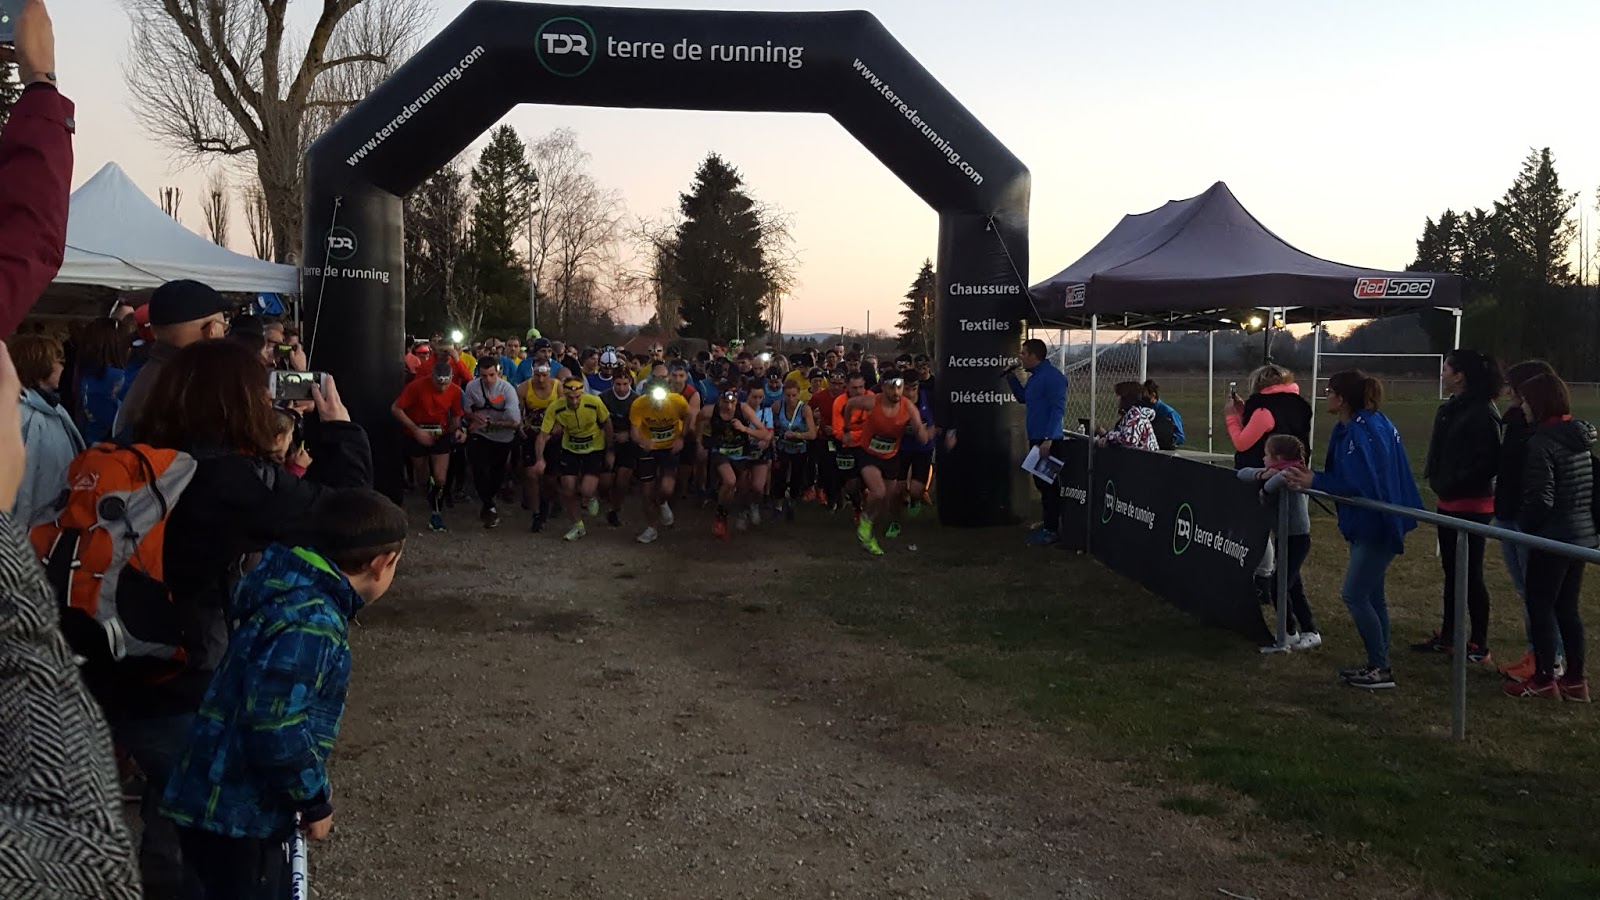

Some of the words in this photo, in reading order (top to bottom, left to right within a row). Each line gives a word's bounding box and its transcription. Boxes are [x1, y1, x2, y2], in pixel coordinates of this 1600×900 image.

[542, 33, 589, 56] TDR
[607, 36, 665, 59] terre
[673, 38, 702, 60] de
[710, 41, 804, 69] running
[346, 44, 485, 167] www.terrederunning.com
[852, 58, 984, 185] www.terrederunning.com
[328, 236, 354, 250] TDR
[304, 267, 321, 276] terre
[324, 265, 338, 277] de
[342, 268, 389, 283] running
[949, 283, 1020, 296] Chaussures
[1357, 279, 1431, 296] RedSpec
[959, 319, 1010, 331] Textiles
[1115, 497, 1128, 515] terre
[1128, 501, 1135, 518] de
[1134, 506, 1156, 530] running
[1194, 524, 1213, 547] terre
[1213, 531, 1224, 551] de
[1223, 540, 1249, 567] running
